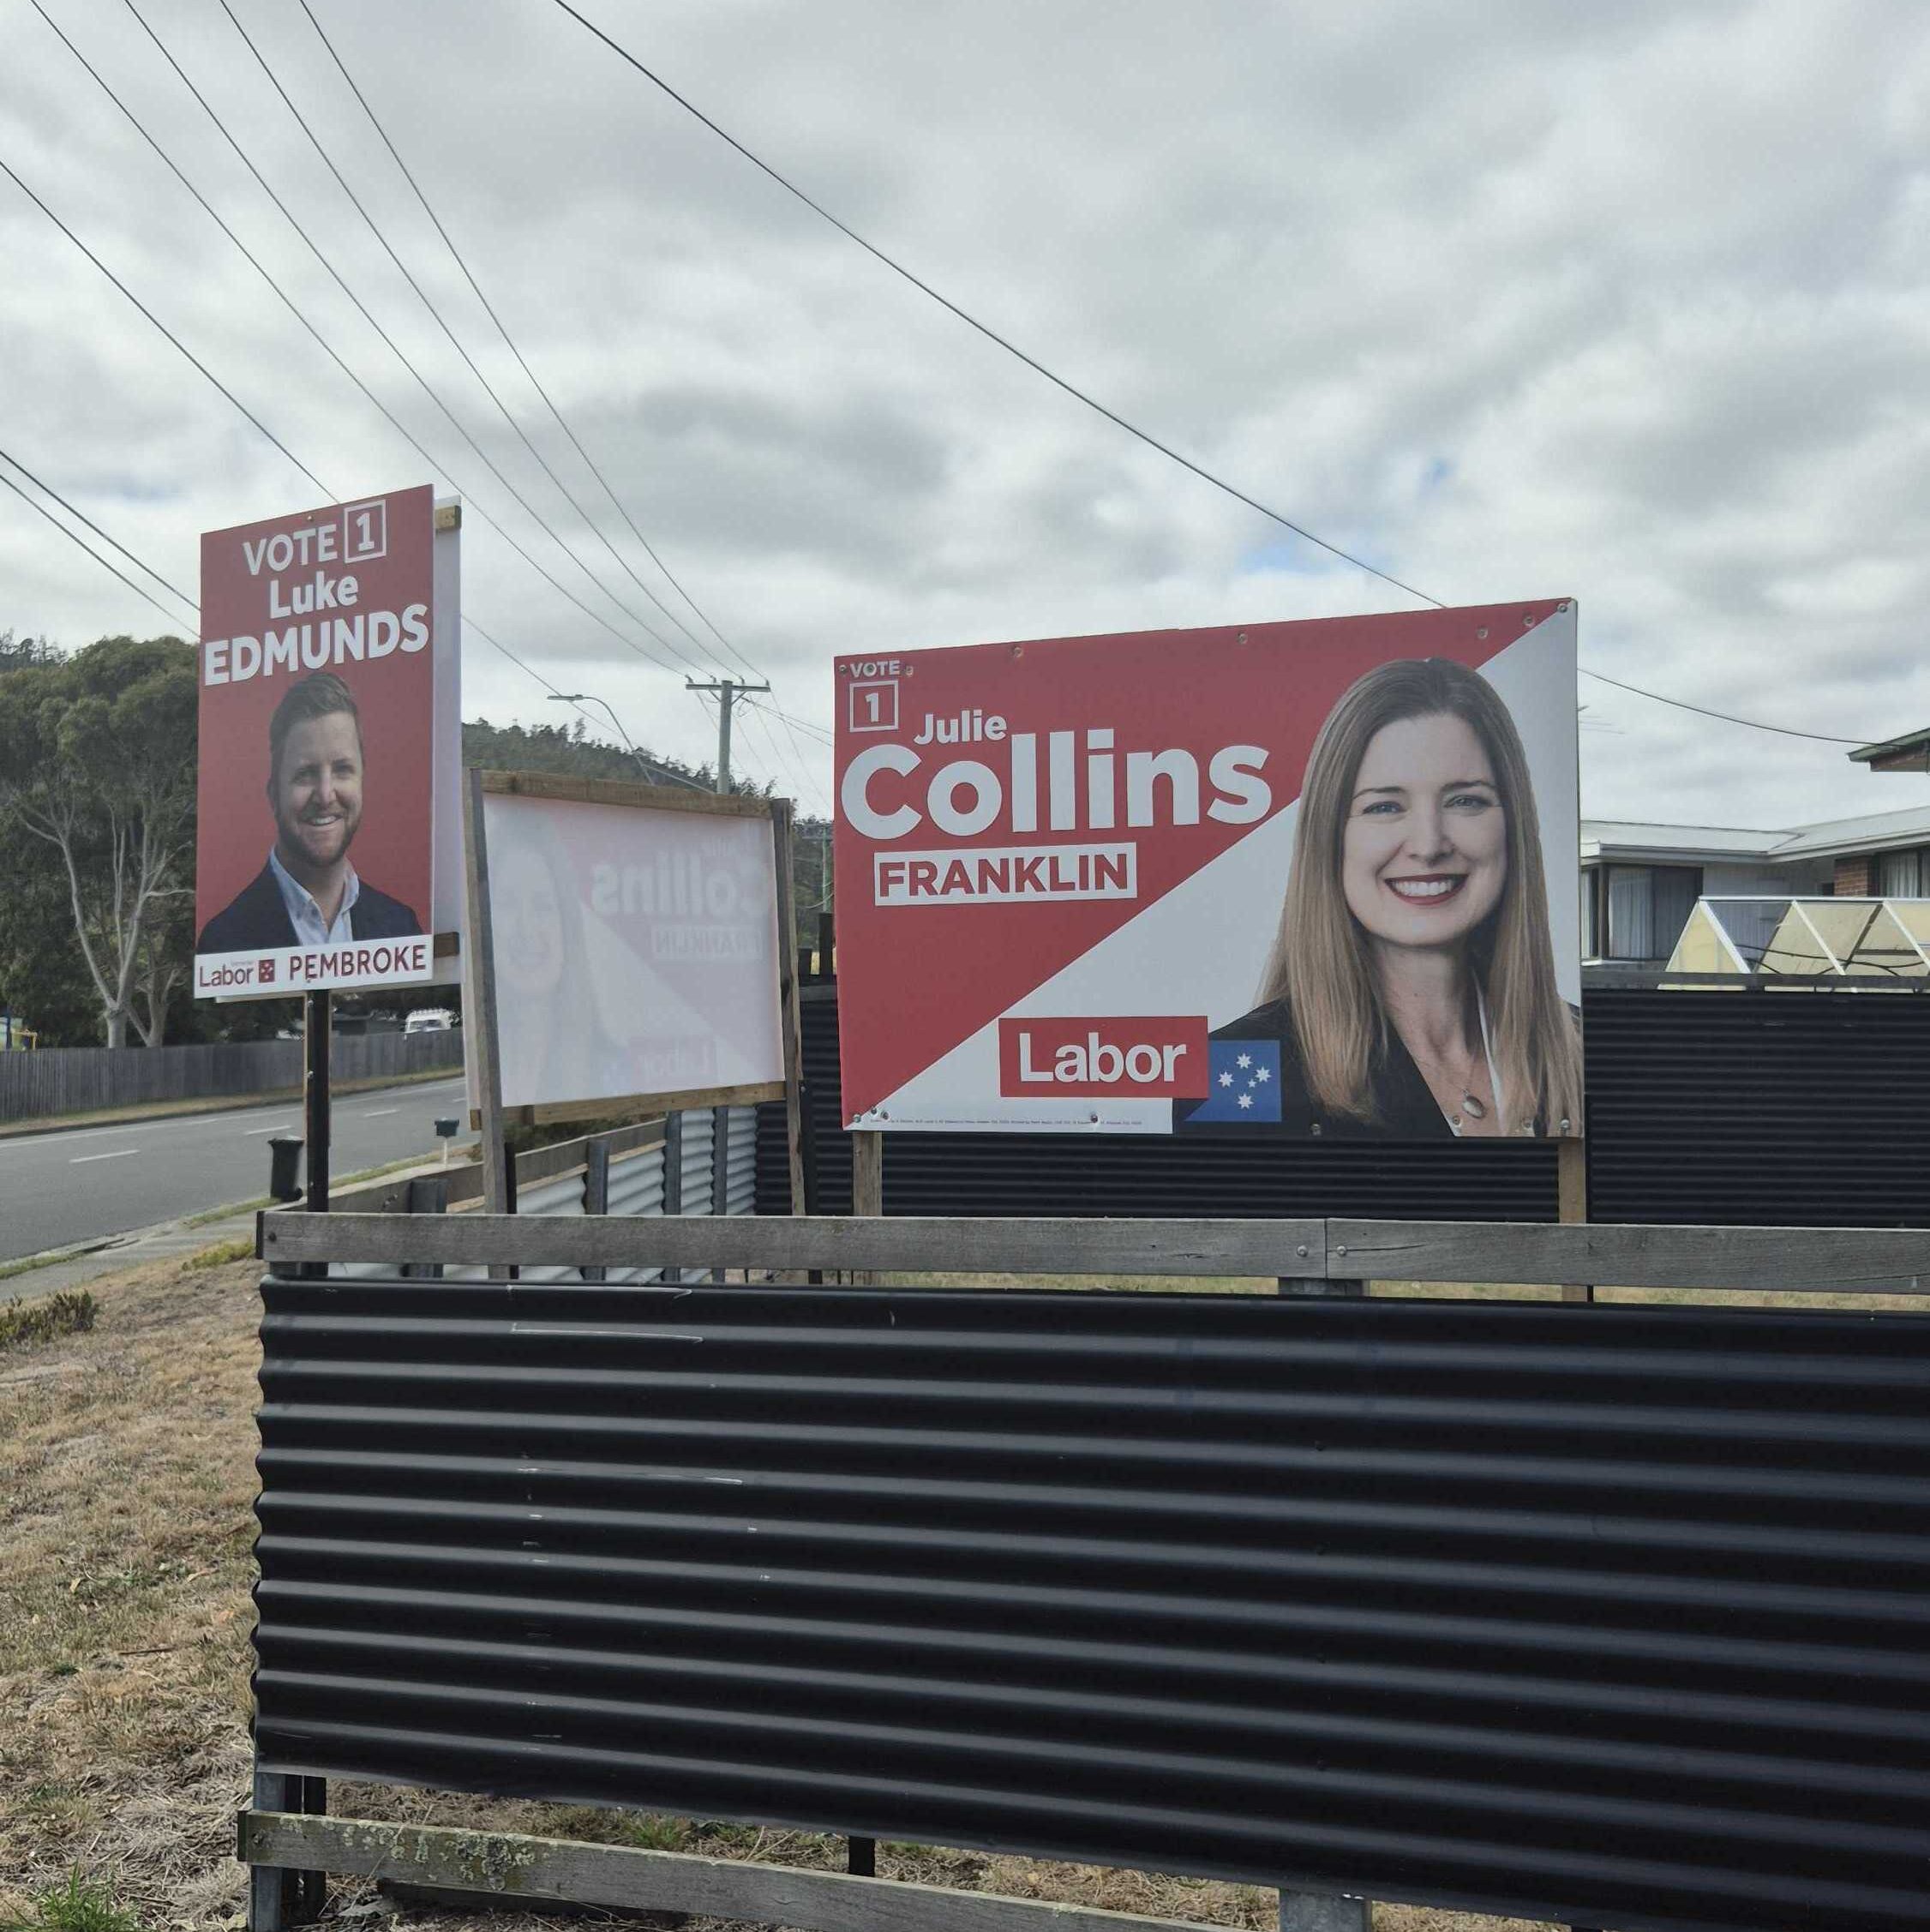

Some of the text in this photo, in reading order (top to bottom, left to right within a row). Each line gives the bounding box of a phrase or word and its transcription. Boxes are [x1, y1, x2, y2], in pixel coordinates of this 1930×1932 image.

[243, 513, 375, 575] VOTE 1
[270, 571, 358, 619] Luke
[205, 603, 429, 686] EDMUNDS
[850, 660, 900, 678] VOTE
[865, 692, 879, 723] 1
[914, 710, 1007, 745] Julie
[841, 729, 1272, 840] Collins
[879, 853, 1128, 897] FRANKLIN
[200, 945, 426, 987] Labor PEMBROKE
[1019, 1032, 1187, 1083] Labor
